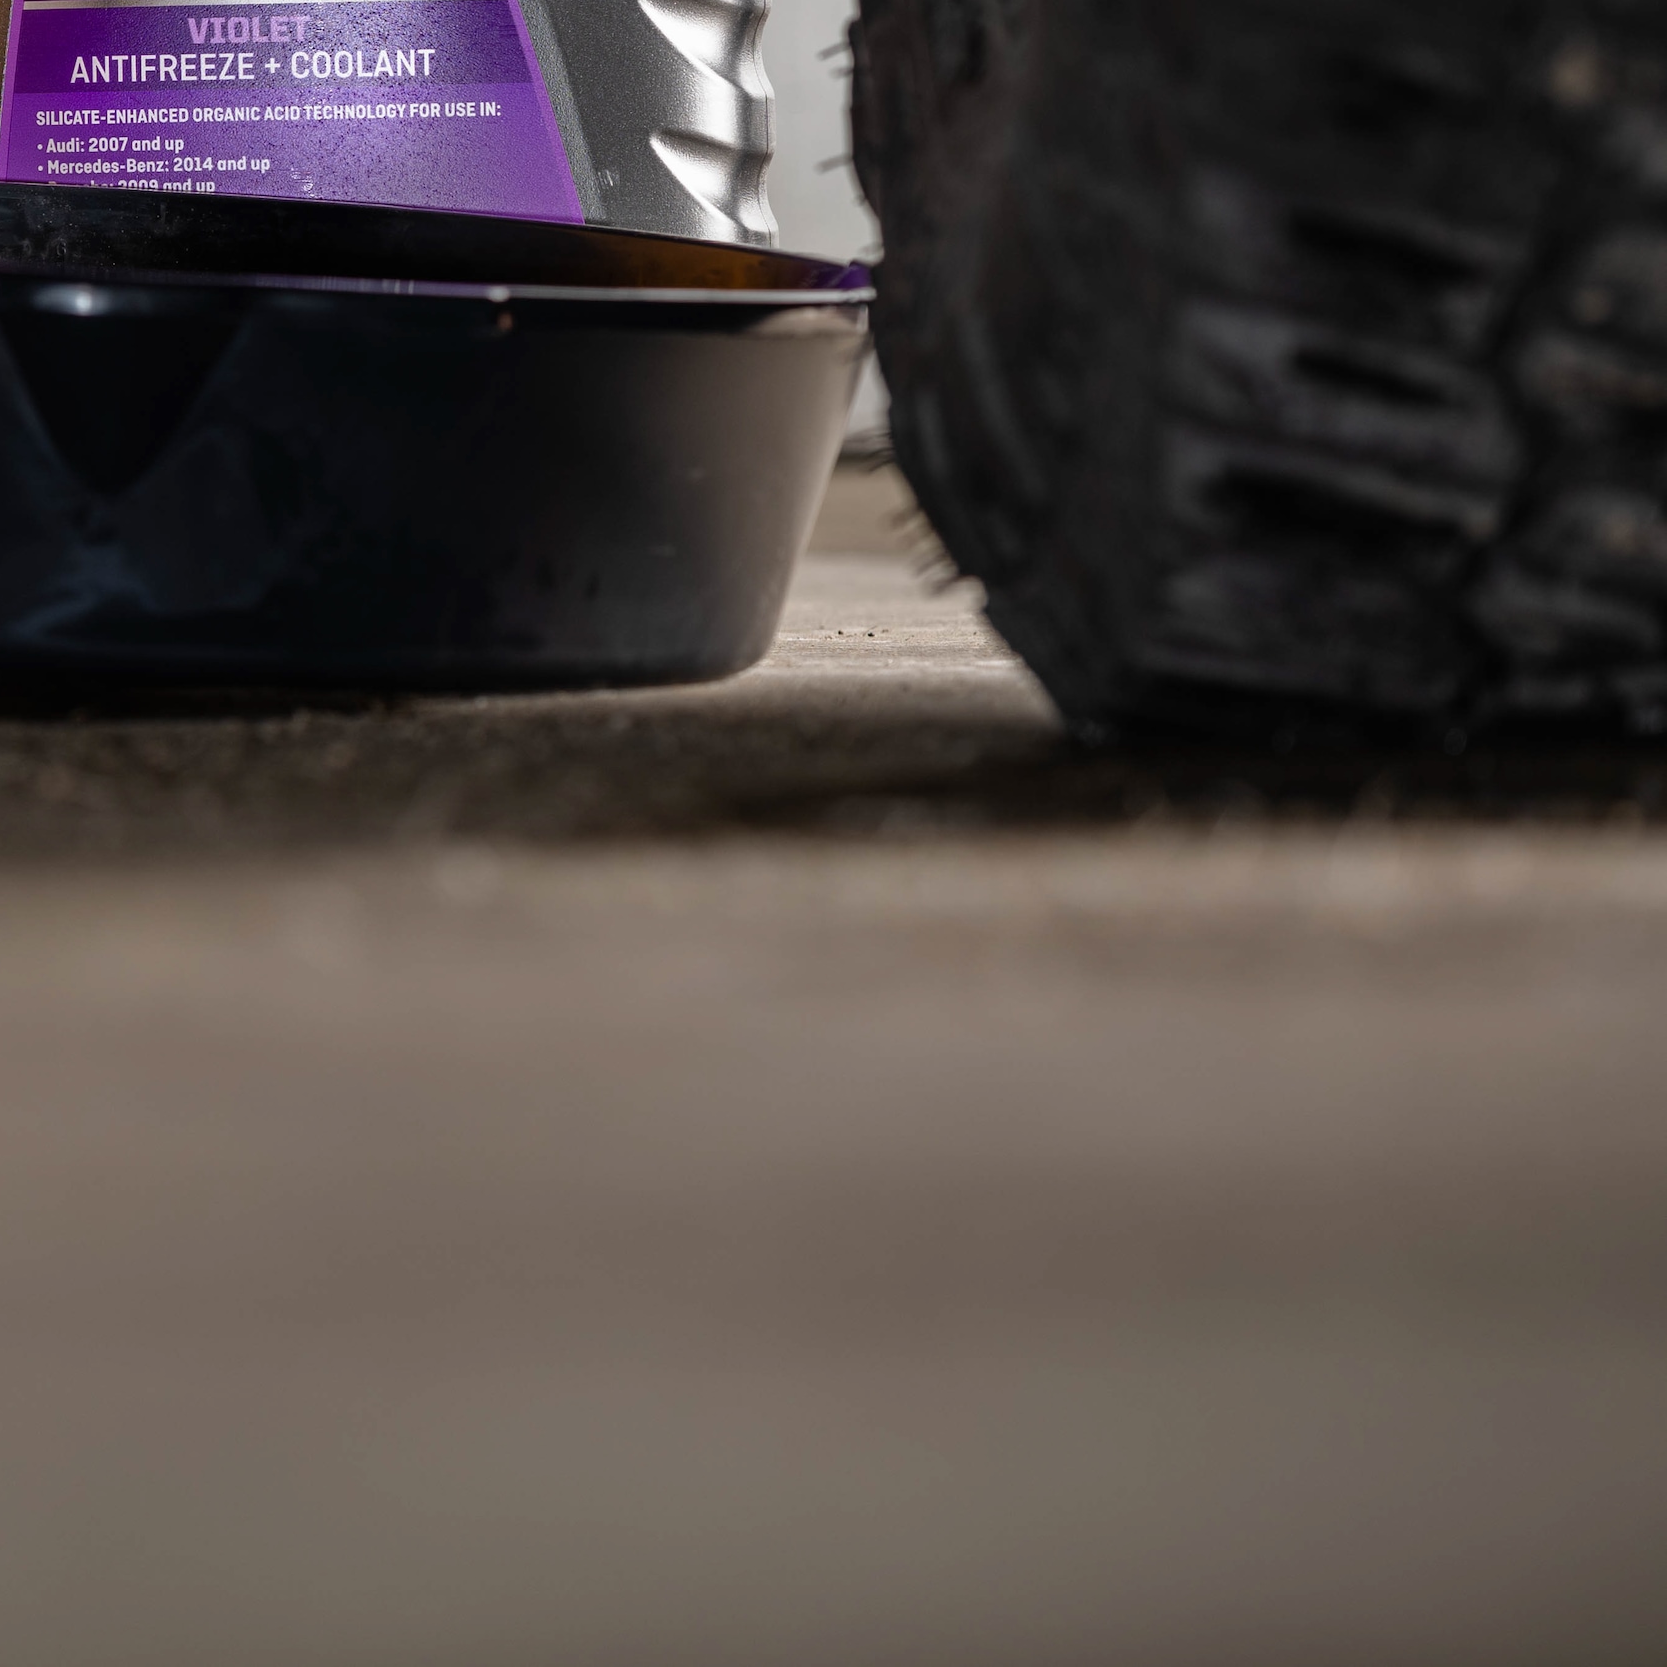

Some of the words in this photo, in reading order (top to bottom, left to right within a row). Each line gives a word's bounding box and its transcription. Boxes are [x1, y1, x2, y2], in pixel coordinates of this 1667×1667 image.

[187, 15, 311, 45] VIOLET
[70, 52, 255, 84] ANTIFREEZE
[264, 58, 281, 75] +
[290, 49, 436, 80] COOLANT
[35, 108, 190, 127] SILICATE-ENHANCED
[192, 106, 261, 123] ORGANIC
[264, 106, 301, 122] ACID
[303, 103, 407, 121] TECHNOLOGY
[409, 102, 441, 118] FOR
[444, 102, 476, 117] USE
[479, 101, 502, 117] IN:
[46, 137, 85, 154] Audi:
[88, 136, 129, 153] 2007
[132, 136, 161, 152] and
[165, 139, 185, 155] up
[47, 157, 170, 175] Mercedes-Benz:
[173, 156, 214, 173] 2014
[217, 156, 248, 172] and
[251, 159, 271, 174] up
[163, 178, 192, 193] and
